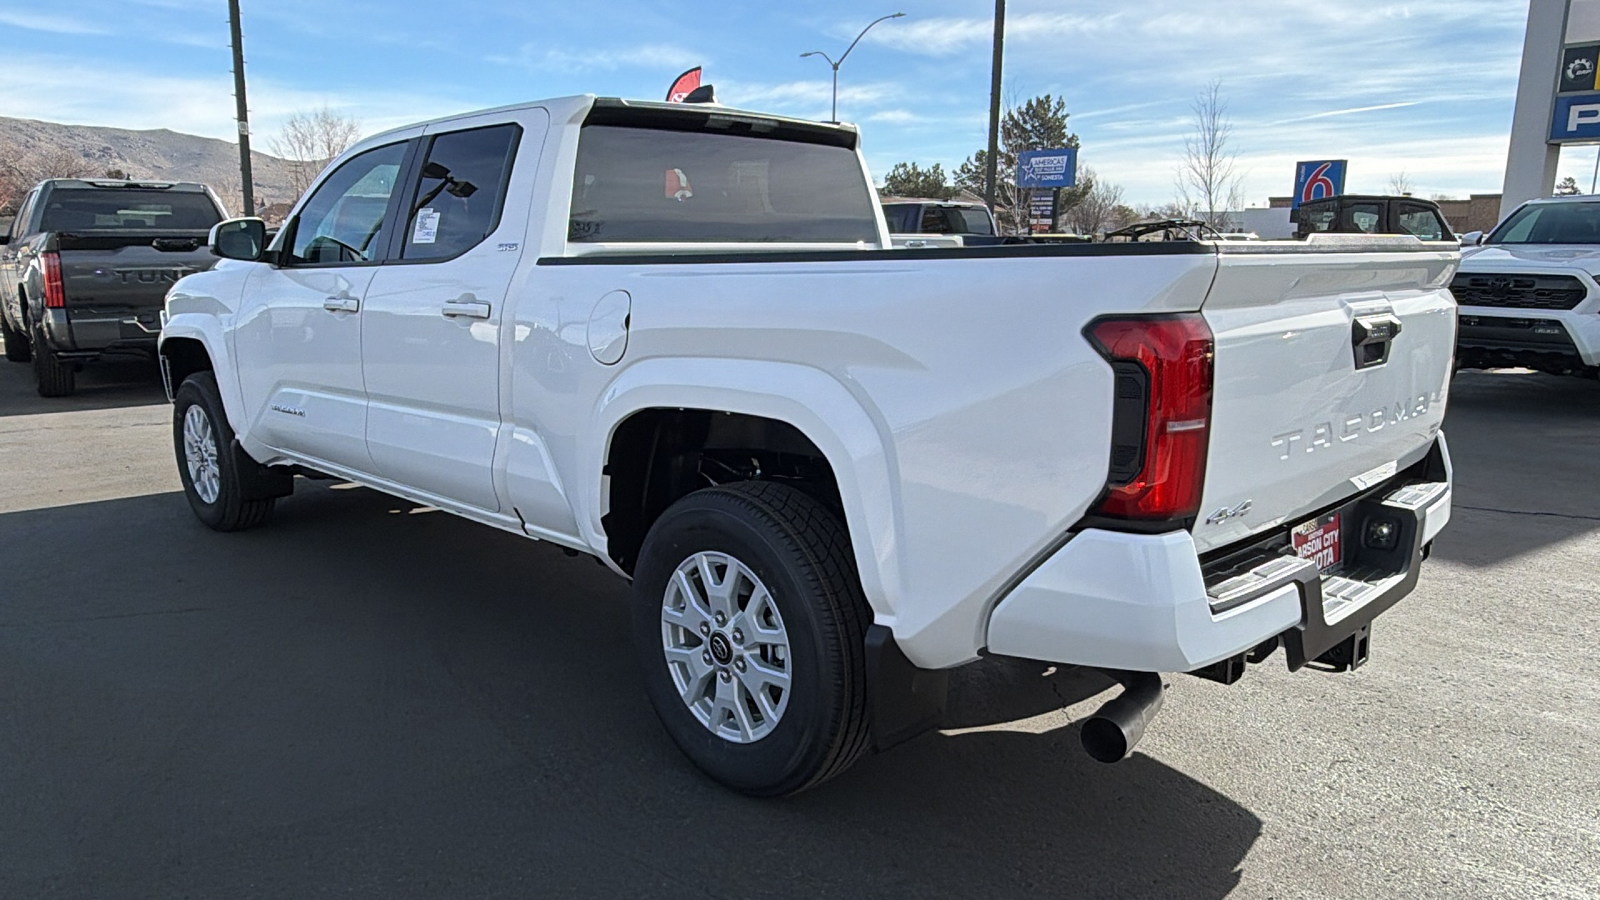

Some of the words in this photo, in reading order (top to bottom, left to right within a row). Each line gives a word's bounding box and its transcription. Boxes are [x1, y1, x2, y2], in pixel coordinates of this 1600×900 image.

[1302, 162, 1334, 203] 6
[113, 269, 198, 284] TUN
[1271, 390, 1429, 461] TACOMA
[1297, 536, 1323, 558] ARSON
[1322, 528, 1340, 548] CITY
